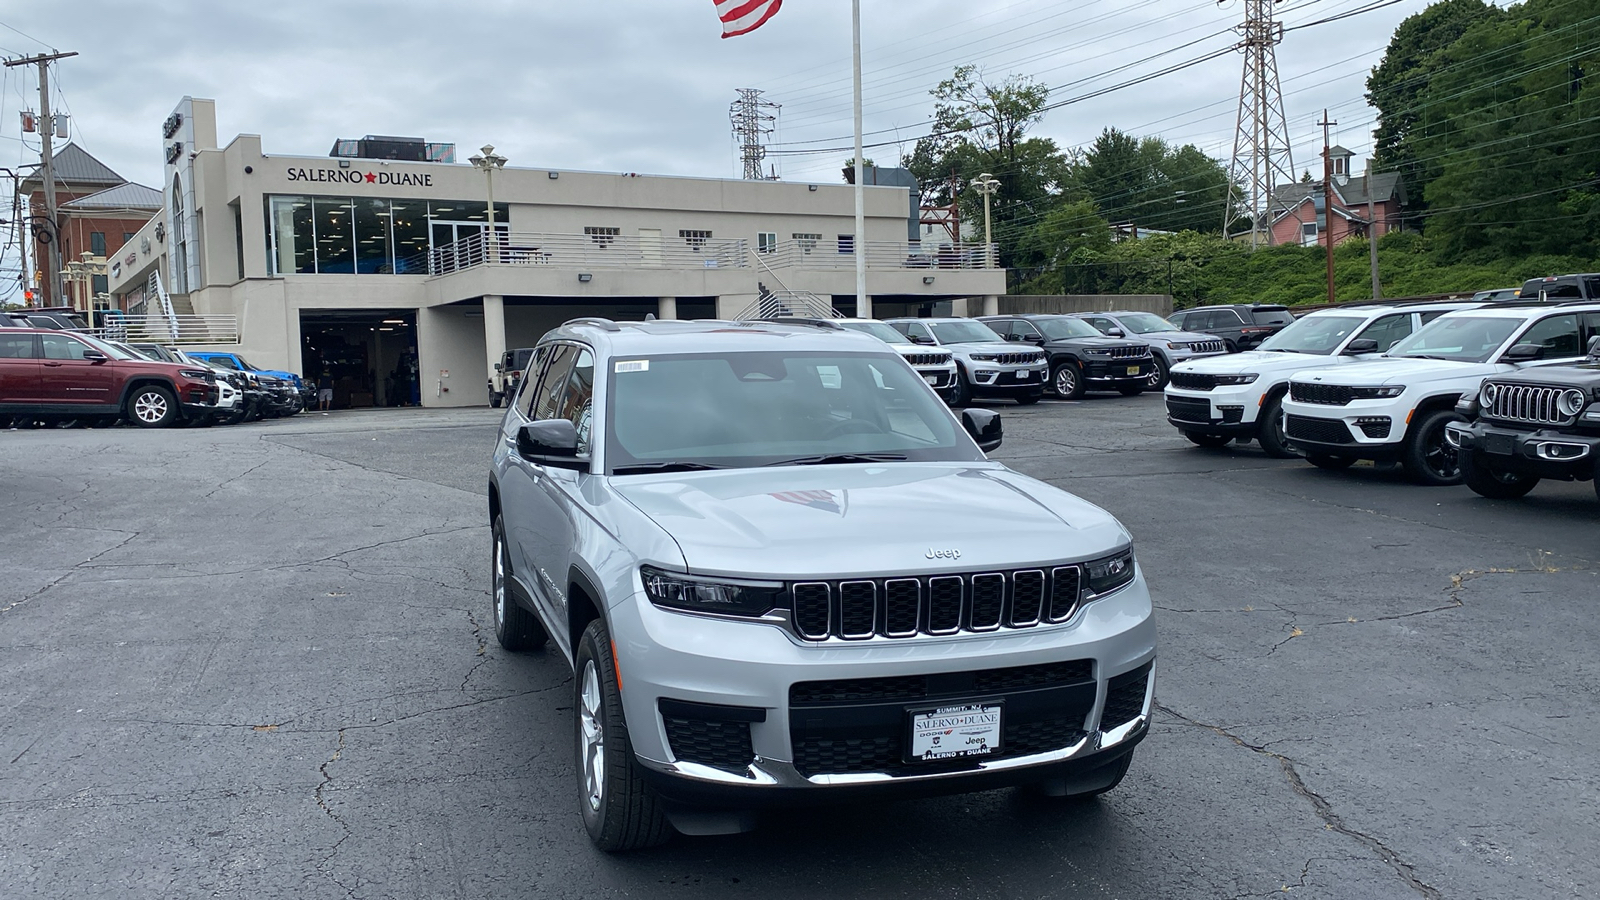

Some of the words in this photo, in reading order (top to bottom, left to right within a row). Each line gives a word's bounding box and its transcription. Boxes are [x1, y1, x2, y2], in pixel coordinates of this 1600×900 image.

[287, 167, 363, 184] SALERNO
[379, 172, 433, 187] DUANE
[925, 547, 961, 560] Jeep
[916, 717, 960, 730] SALERNO
[964, 714, 997, 724] DUANE
[965, 737, 986, 745] Jeep
[922, 752, 956, 760] SALERNO
